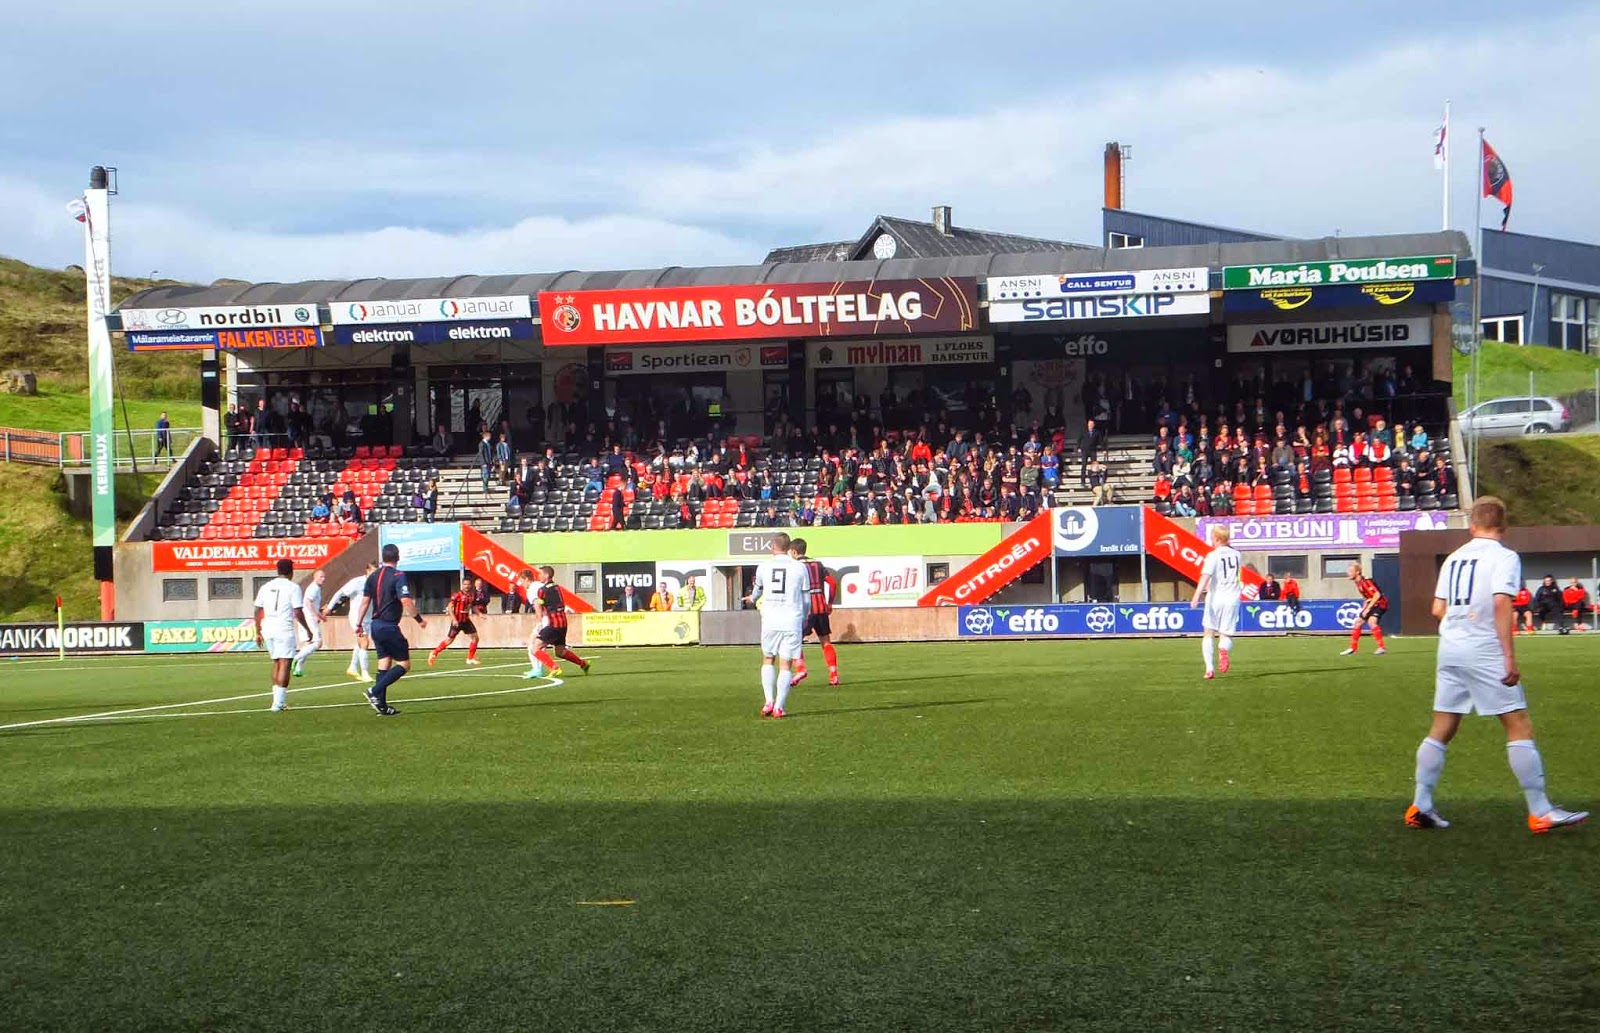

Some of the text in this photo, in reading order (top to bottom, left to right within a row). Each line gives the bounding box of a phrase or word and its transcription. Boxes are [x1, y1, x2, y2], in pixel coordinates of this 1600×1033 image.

[1000, 279, 1041, 288] ANSNI
[1153, 271, 1195, 280] ANSNI
[1249, 262, 1428, 286] Maria Poulsen
[200, 308, 282, 325] nordbil
[592, 288, 922, 331] HAVNAR BÓLTFELAG
[218, 329, 317, 348] FALKENBERG
[352, 329, 414, 343] elektron
[448, 326, 511, 340] elektron
[847, 341, 922, 364] mylnan
[1065, 335, 1108, 355] effo
[641, 353, 731, 370] Sportigan
[96, 433, 108, 495] KEMILUX
[1229, 518, 1334, 539] FÓTBÚNI
[173, 542, 328, 559] VALDEMAR LÜTZEN
[1221, 556, 1239, 579] 14
[605, 574, 653, 588] TRYGD
[771, 568, 787, 594] 9
[867, 567, 918, 595] Svali
[270, 589, 280, 611] 7
[1008, 609, 1059, 632] effo
[1132, 607, 1184, 630] effo
[0, 627, 132, 649] ANKNORDIK
